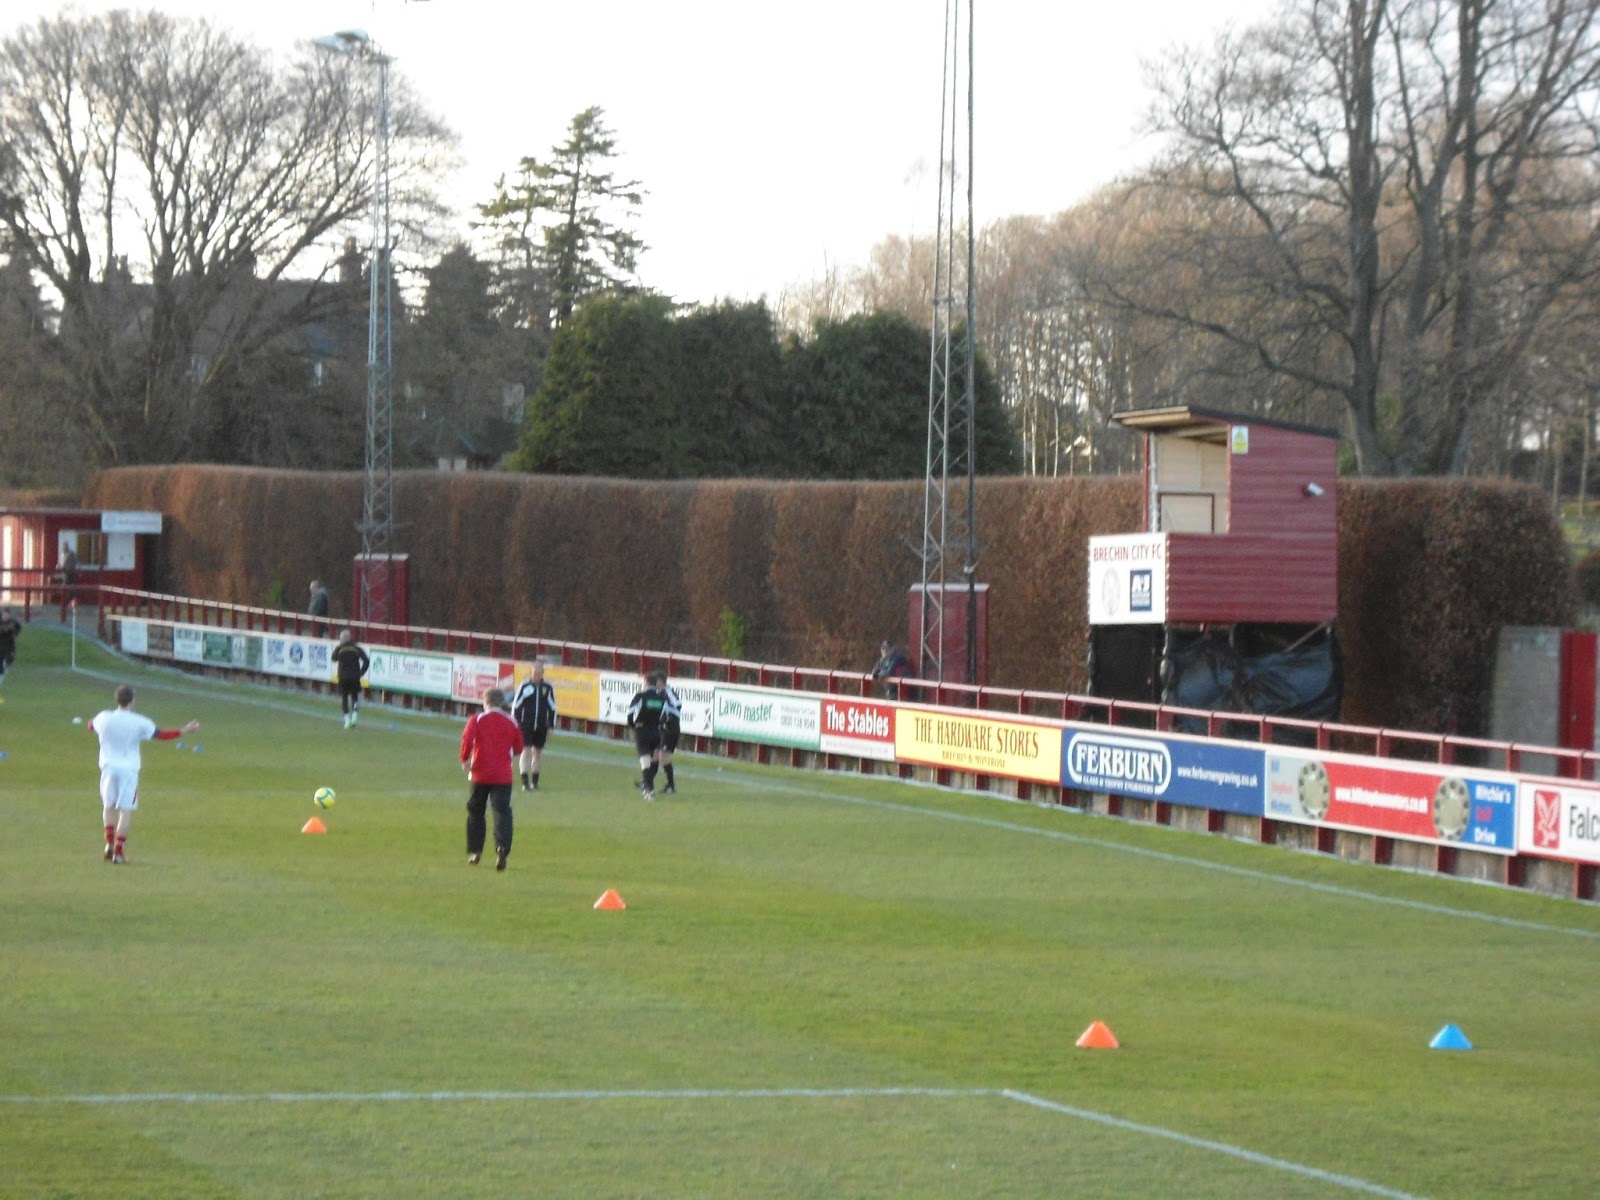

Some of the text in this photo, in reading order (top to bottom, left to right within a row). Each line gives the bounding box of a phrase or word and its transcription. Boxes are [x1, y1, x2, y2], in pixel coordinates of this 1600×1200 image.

[1093, 543, 1162, 562] BRECHIN CITY FC
[600, 678, 631, 694] SCOTTISH
[718, 696, 742, 720] Lawn
[743, 702, 773, 723] master
[826, 703, 889, 738] The Stables
[914, 716, 1040, 759] THE HARDWARE STORES
[1076, 743, 1164, 784] FERBURN
[1474, 826, 1497, 845] Drive
